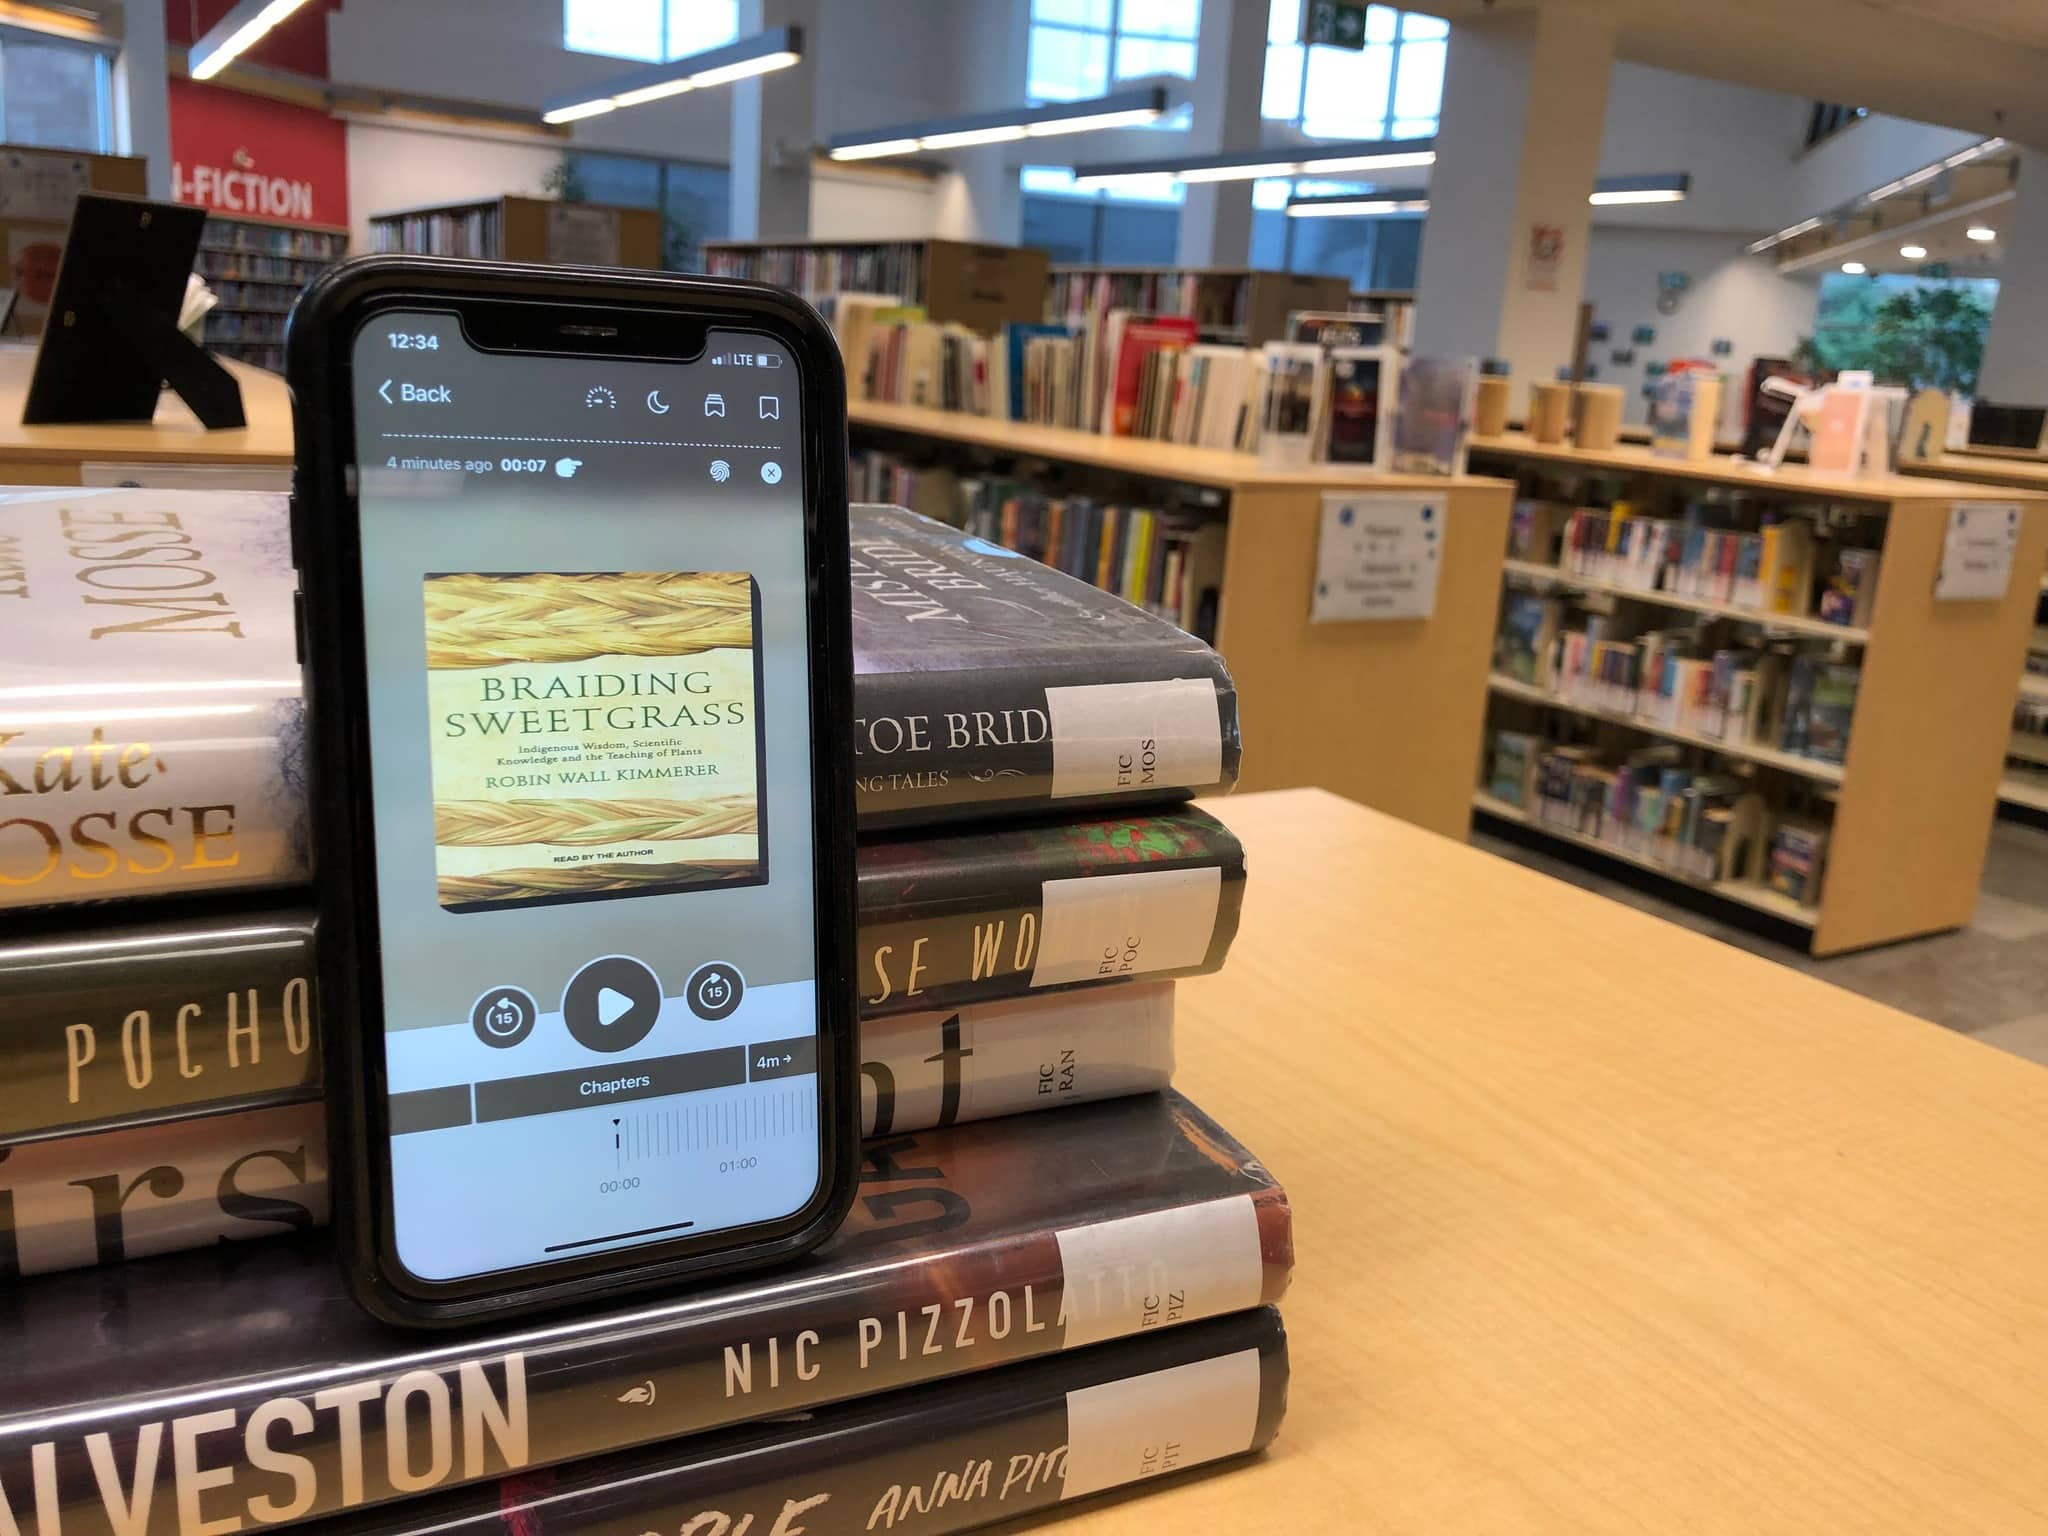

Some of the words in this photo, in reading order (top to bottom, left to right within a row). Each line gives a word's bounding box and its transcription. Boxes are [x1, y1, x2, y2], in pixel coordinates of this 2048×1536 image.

[388, 333, 440, 350] 12:34
[733, 353, 754, 367] LTE
[401, 383, 452, 403] Back
[386, 456, 398, 469] 4
[401, 457, 462, 471] minutes
[465, 461, 493, 473] ago
[500, 458, 547, 472] 00:07
[480, 671, 713, 702] BRAIDING
[445, 701, 746, 738] SWEETGRASS
[497, 756, 559, 766] Knowledge
[561, 754, 582, 763] and
[586, 752, 603, 761] the
[608, 750, 654, 761] Teaching
[657, 748, 668, 758] of
[671, 747, 703, 756] Plants
[519, 743, 580, 755] Indigenous
[582, 742, 629, 752] Wisdom,
[632, 738, 683, 748] Scientific
[1117, 754, 1133, 786] FIC
[1140, 738, 1156, 784] MOS
[485, 773, 551, 789] ROBIN
[558, 770, 611, 784] WALL
[616, 764, 720, 781] KIMMERER
[887, 769, 950, 791] TALES
[553, 855, 580, 863] READ
[581, 853, 594, 861] BY
[596, 852, 615, 860] THE
[616, 849, 654, 859] AUTHOR
[868, 937, 929, 1005] SE
[971, 912, 1036, 982] WO
[1098, 946, 1119, 974] FIC
[1118, 935, 1141, 972] POC
[707, 986, 722, 998] 15
[496, 1012, 513, 1025] 15
[65, 977, 311, 1104] POCHO
[756, 1054, 781, 1070] 4m
[1058, 1048, 1076, 1092] RAN
[579, 1073, 651, 1097] Chapters
[1038, 1063, 1055, 1095] FIC
[719, 1156, 758, 1173] 01:00
[599, 1176, 641, 1194] 00:00
[1141, 1295, 1160, 1328] FIC
[1166, 1289, 1185, 1323] PIZ
[723, 1330, 821, 1398] NIC
[0, 1351, 530, 1536] LVESTON
[1162, 1440, 1182, 1470] PIT
[1141, 1447, 1160, 1476] FIC
[865, 1459, 993, 1530] ANNA
